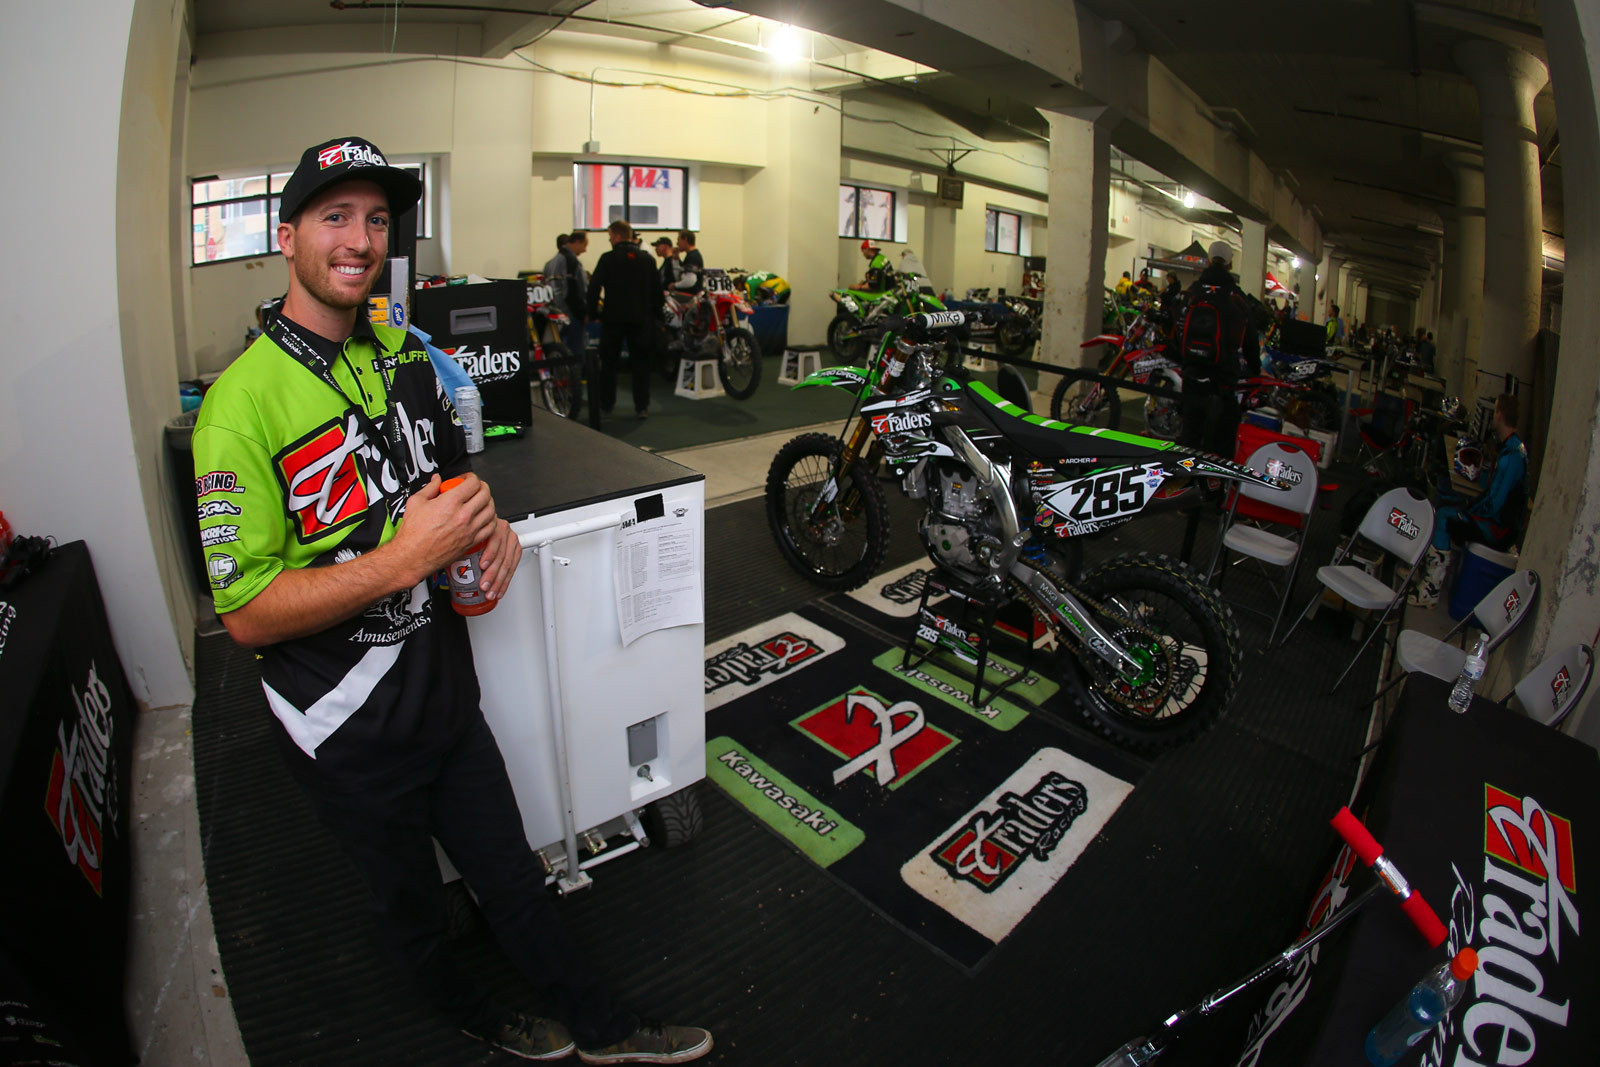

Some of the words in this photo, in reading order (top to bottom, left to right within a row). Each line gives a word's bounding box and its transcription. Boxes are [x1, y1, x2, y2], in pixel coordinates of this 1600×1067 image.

[707, 277, 732, 292] 918
[370, 297, 388, 326] PR
[871, 412, 932, 434] Traders
[1068, 465, 1145, 521] 285
[1054, 520, 1100, 538] Traders
[1390, 508, 1420, 538] Traders
[450, 559, 475, 585] G
[916, 624, 940, 643] 285
[936, 617, 967, 640] Traders
[705, 640, 808, 690] Trader
[718, 749, 840, 837] Kawasaki
[954, 774, 1084, 876] Traders
